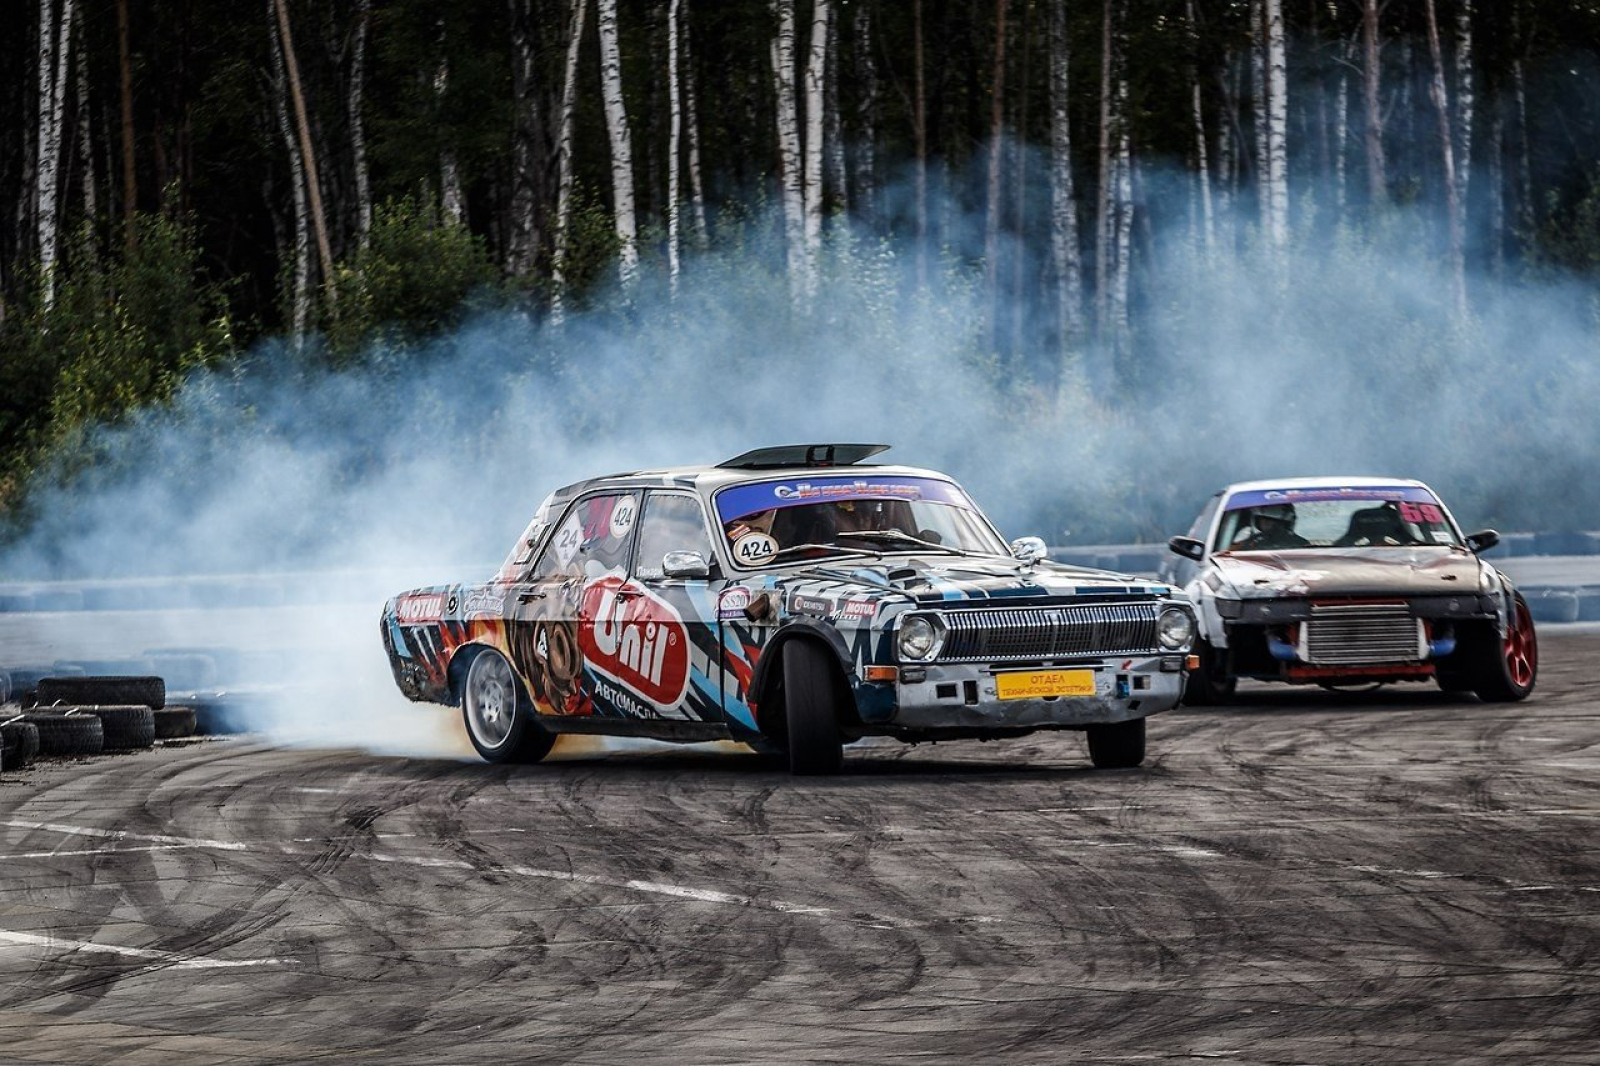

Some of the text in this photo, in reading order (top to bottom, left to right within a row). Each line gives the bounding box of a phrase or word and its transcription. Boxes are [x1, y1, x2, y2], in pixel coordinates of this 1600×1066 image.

[614, 507, 633, 526] 424
[560, 529, 578, 548] 24
[741, 540, 772, 557] 424
[399, 597, 441, 619] MOTUL
[846, 602, 875, 615] MOTUL
[594, 588, 669, 686] Unil
[1030, 674, 1065, 684] ОТДЕЛ
